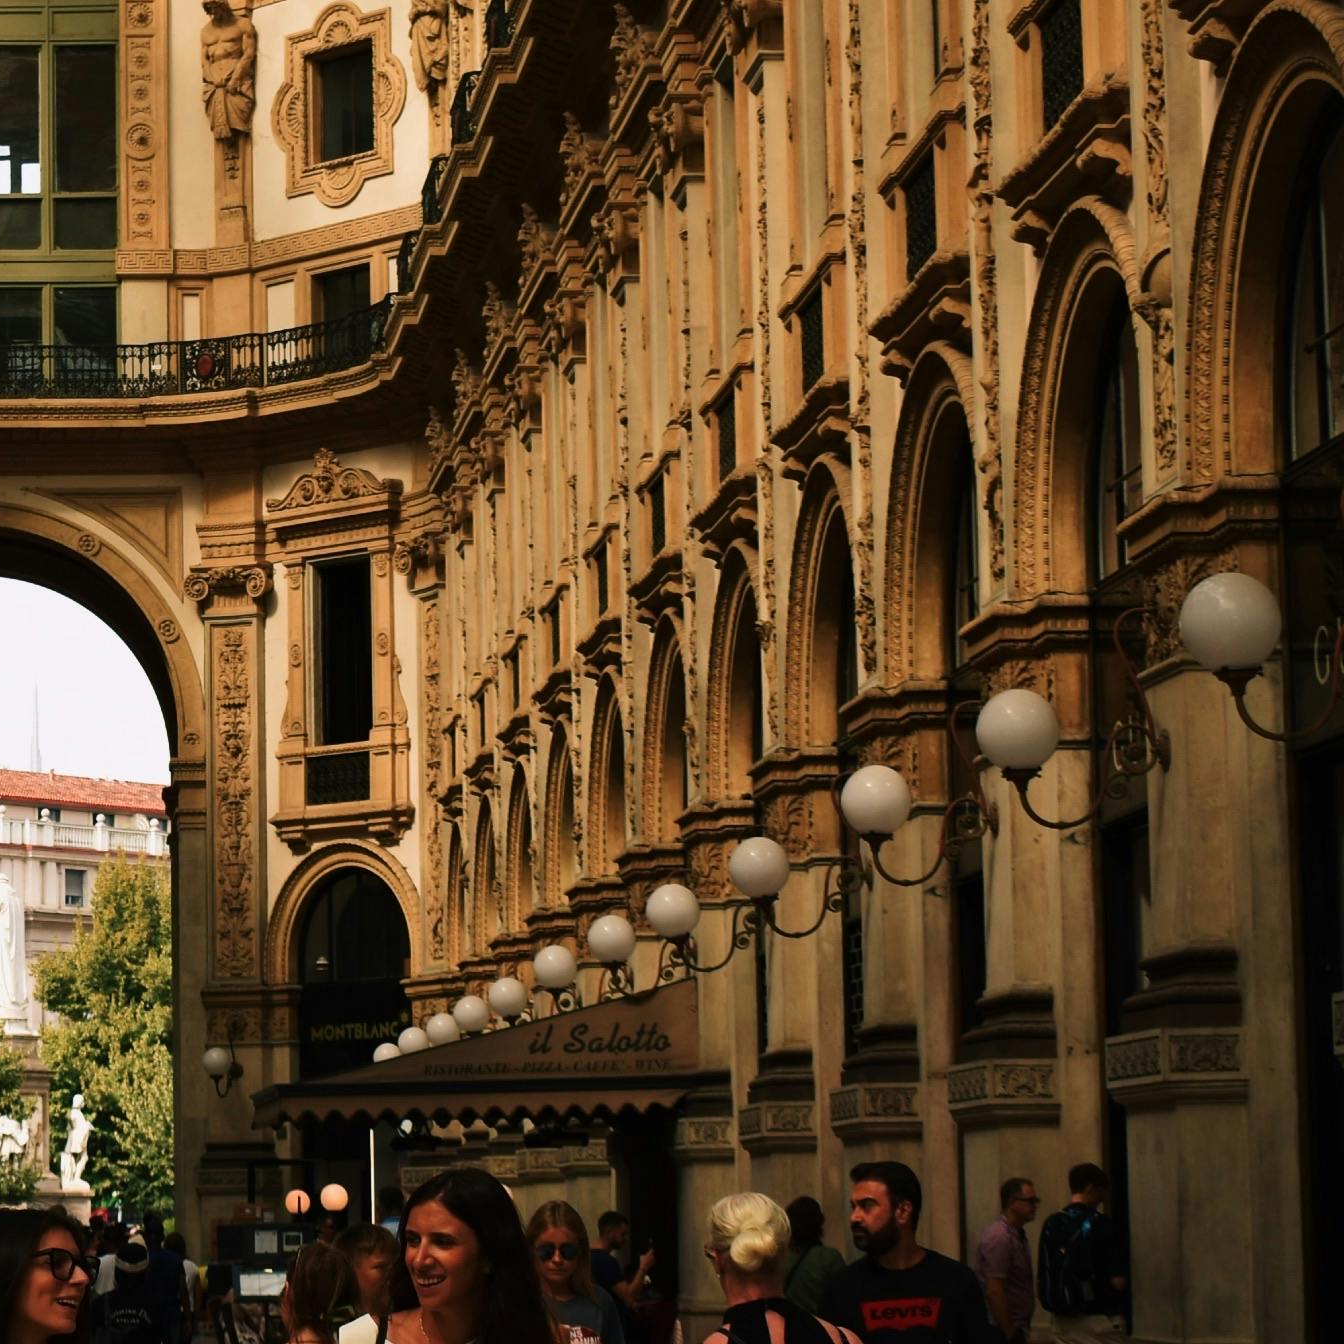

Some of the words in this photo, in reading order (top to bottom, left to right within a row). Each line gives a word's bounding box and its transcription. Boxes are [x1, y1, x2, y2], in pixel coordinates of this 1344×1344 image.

[311, 1021, 399, 1041] MONTBLANC
[528, 1024, 553, 1055] il
[563, 1022, 672, 1054] Salotto
[424, 1062, 512, 1076] RISTORANTE
[522, 1061, 563, 1074] PIZZA
[635, 1058, 673, 1072] WINE
